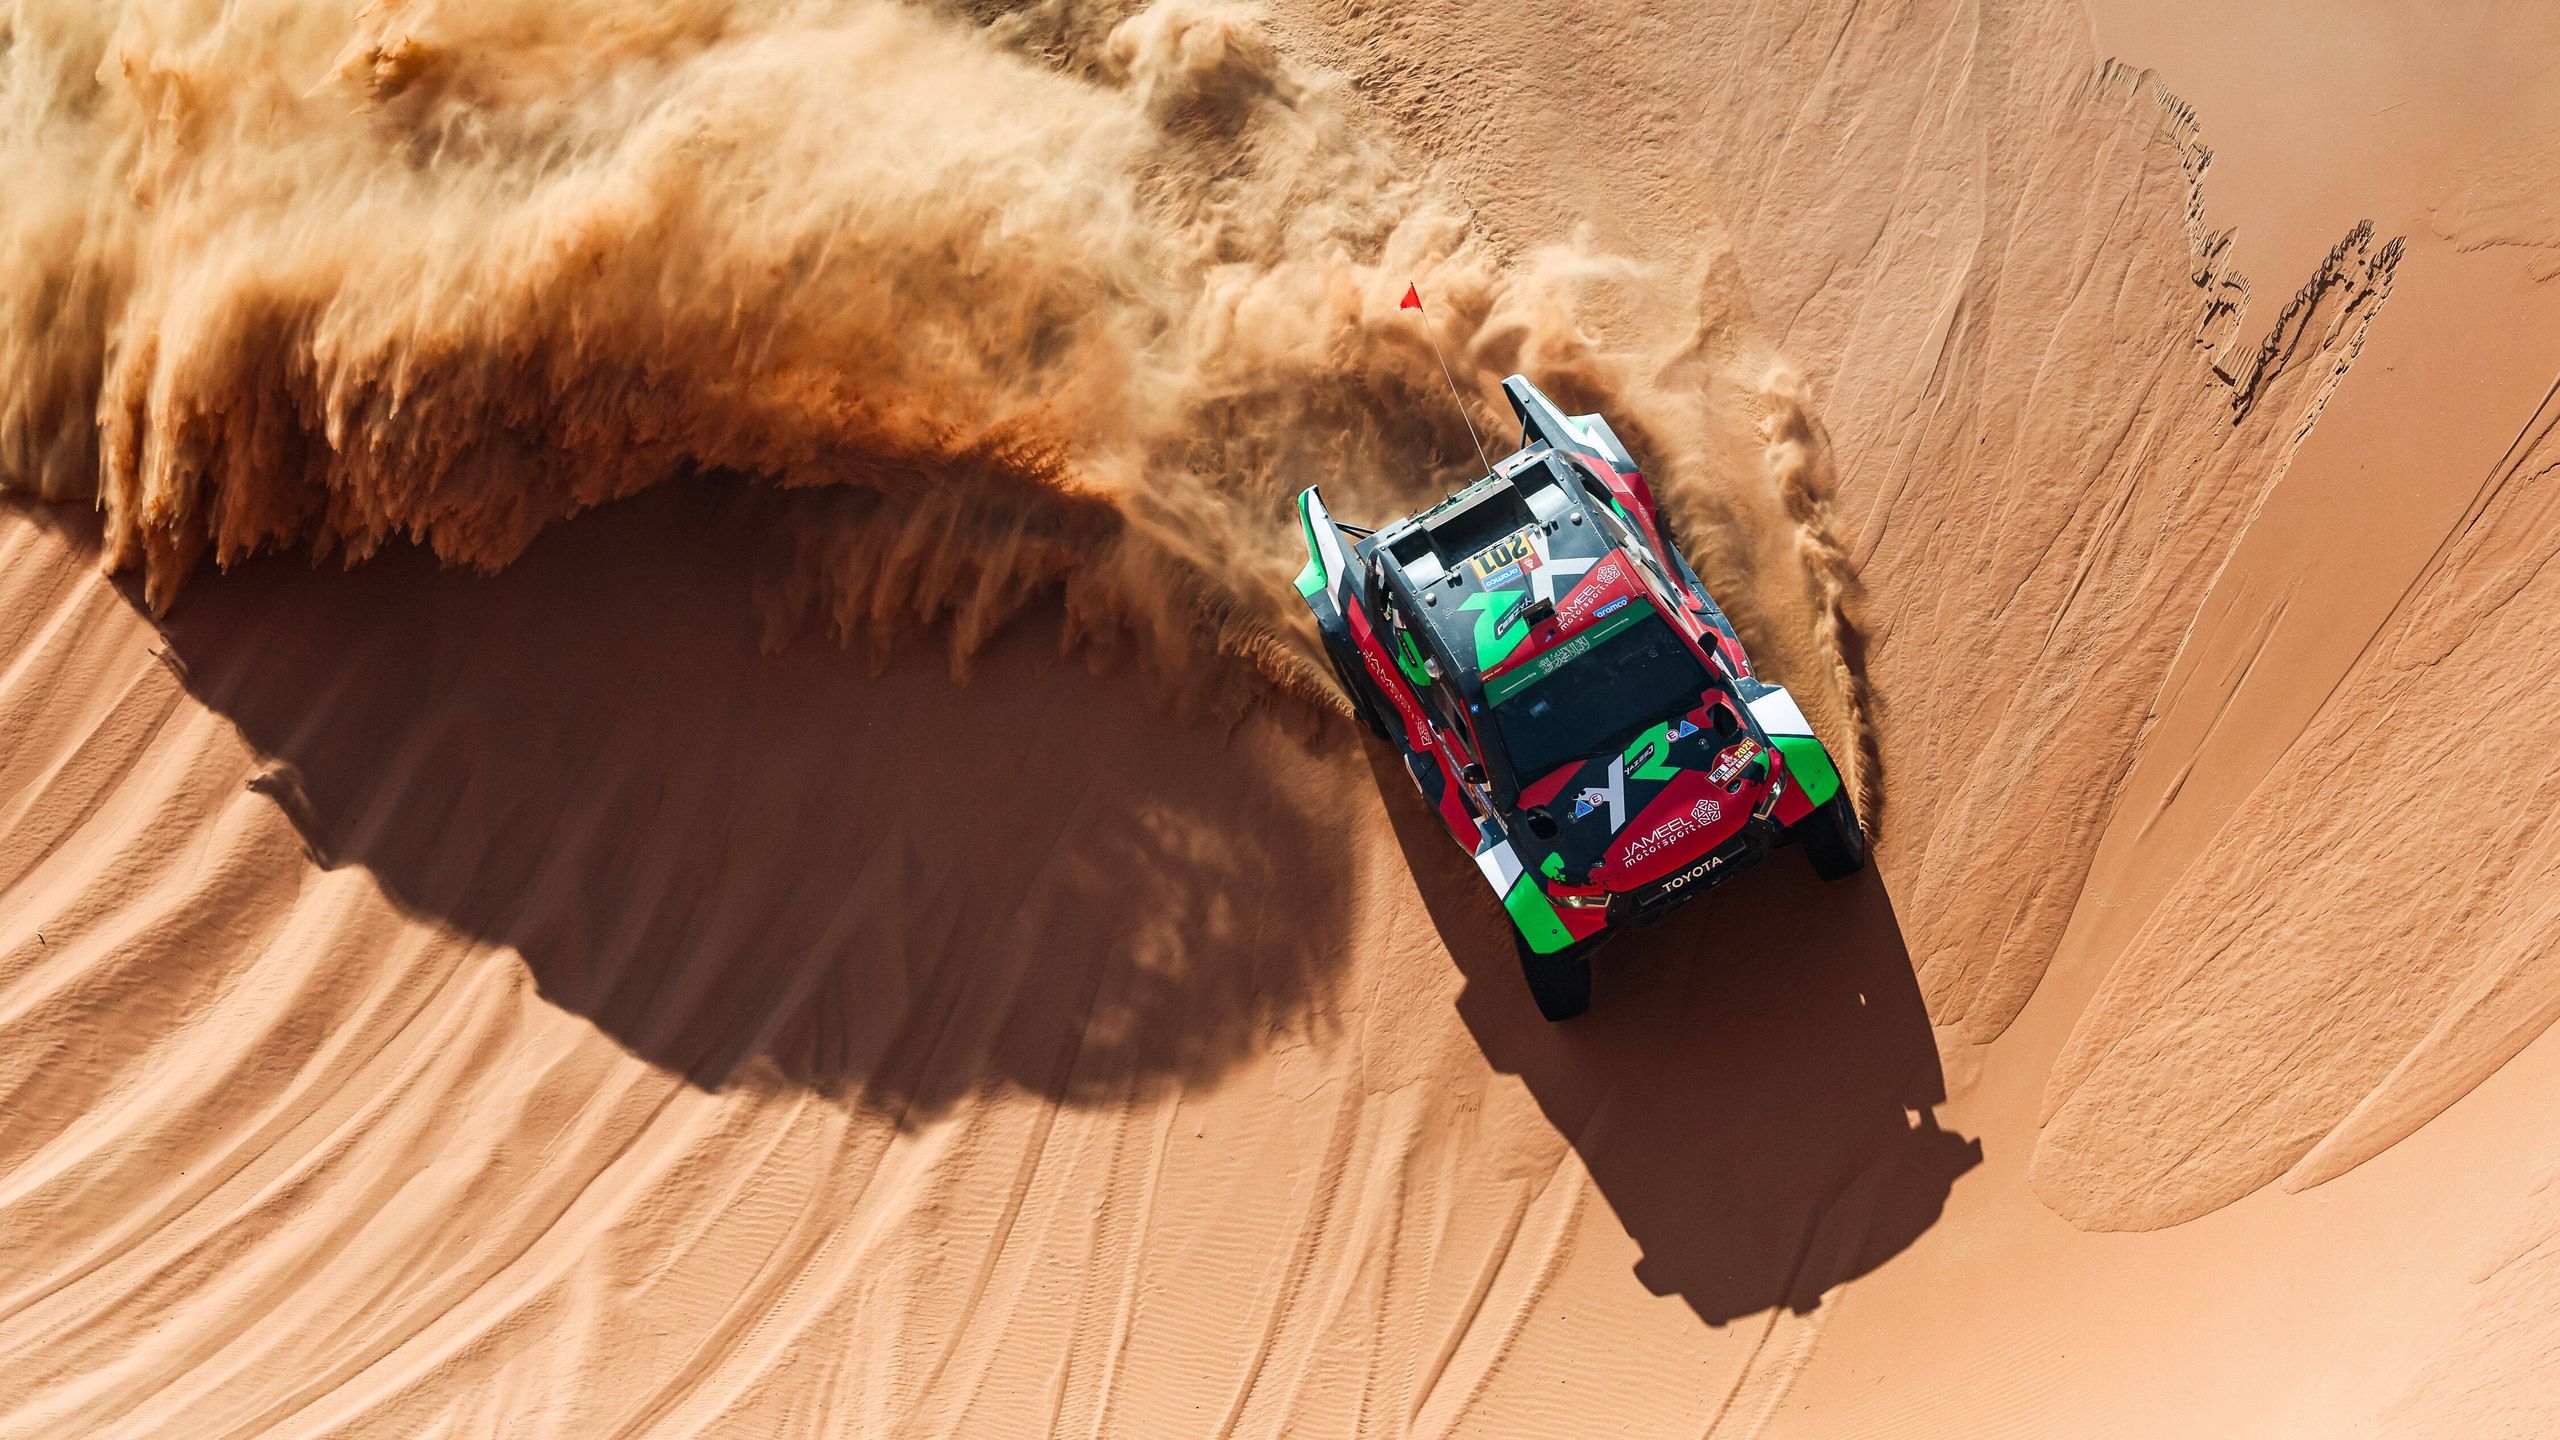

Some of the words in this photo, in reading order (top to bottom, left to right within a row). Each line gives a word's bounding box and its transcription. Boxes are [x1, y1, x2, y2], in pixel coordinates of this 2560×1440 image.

[1479, 533, 1528, 575] 201
[1485, 567, 1519, 588] aramco
[1555, 583, 1601, 628] JAMEEL
[1560, 584, 1606, 631] motorsport
[1596, 599, 1628, 618] aramco
[1721, 766, 1739, 782] SAUDI
[1735, 750, 1755, 769] ARABIA
[1734, 739, 1755, 759] 2025
[1712, 769, 1725, 780] 201
[1622, 816, 1693, 861] JAMEEL
[1624, 823, 1697, 868] motorsport
[1661, 856, 1723, 893] TOYOTA
